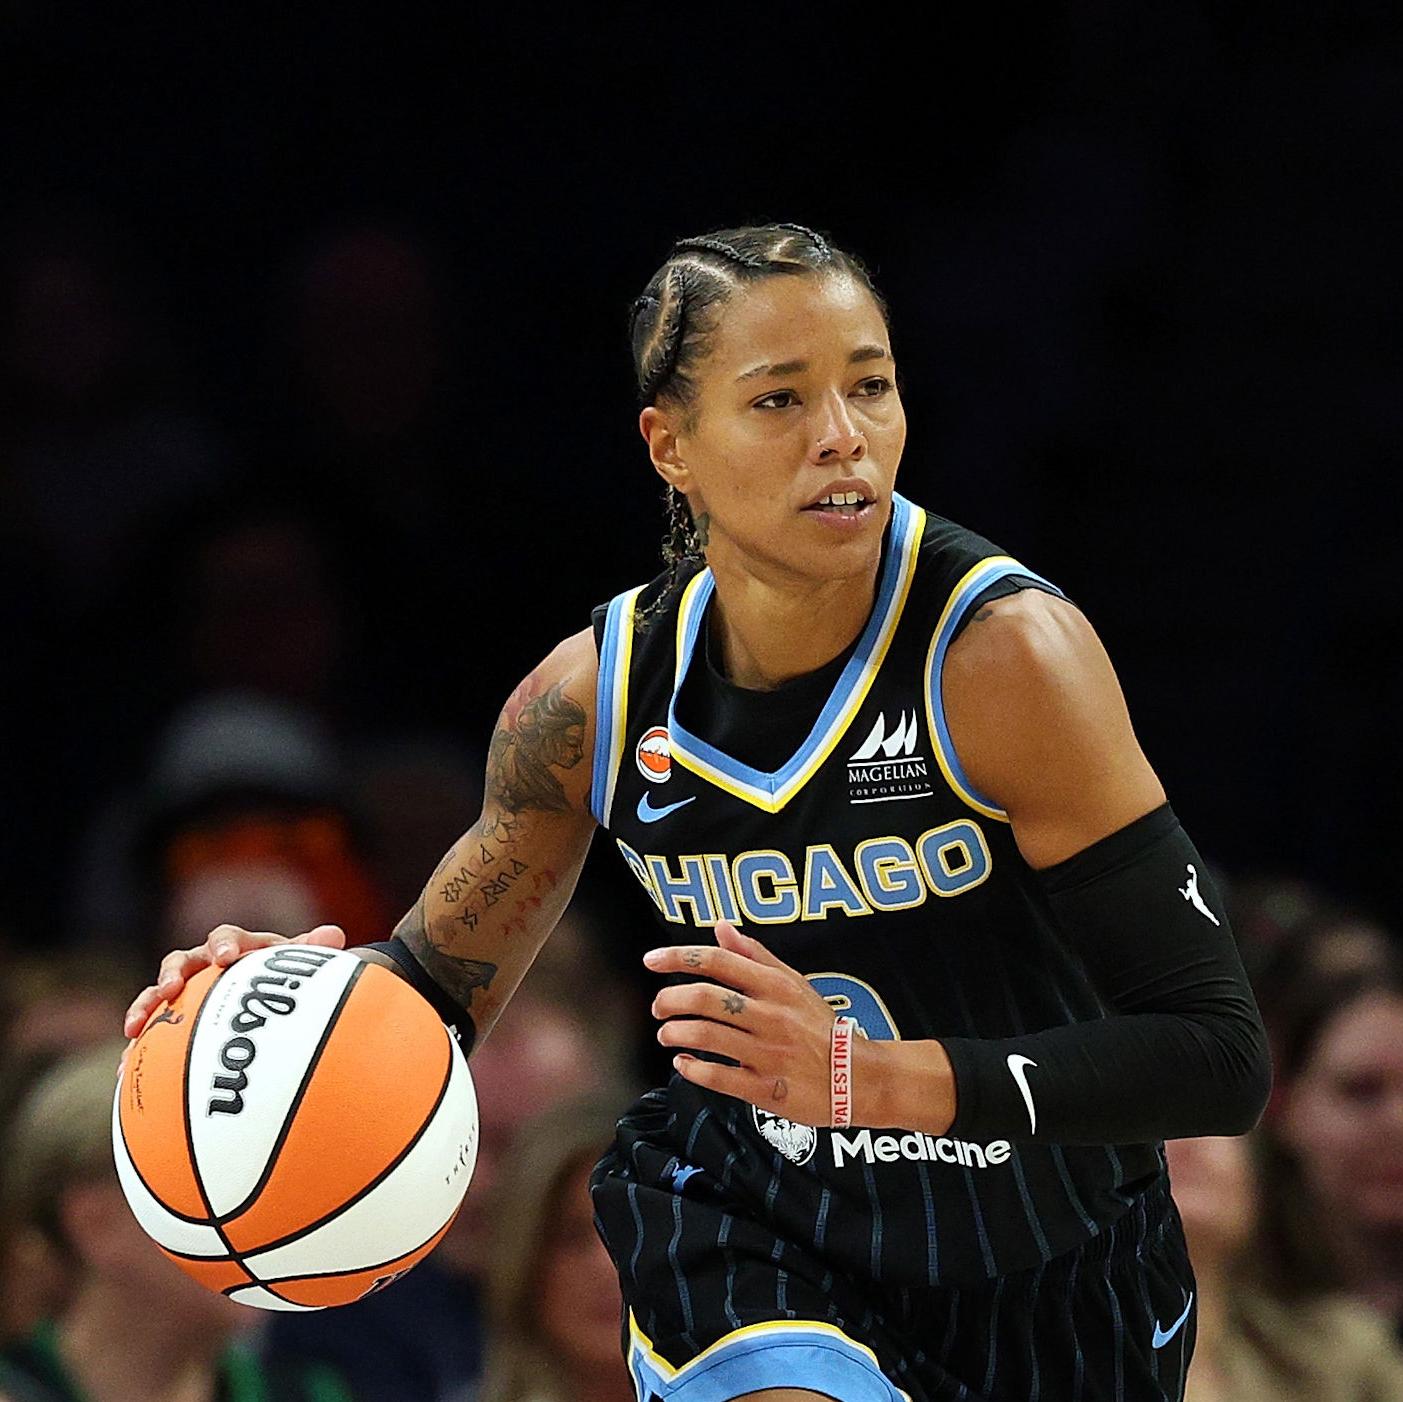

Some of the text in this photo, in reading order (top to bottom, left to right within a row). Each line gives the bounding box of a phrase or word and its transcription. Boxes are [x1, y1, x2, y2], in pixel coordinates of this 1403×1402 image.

[848, 763, 927, 783] MAGELLAN
[206, 948, 338, 1118] Wilson
[834, 1029, 848, 1124] PALESTINE
[830, 1129, 1011, 1168] Medicine
